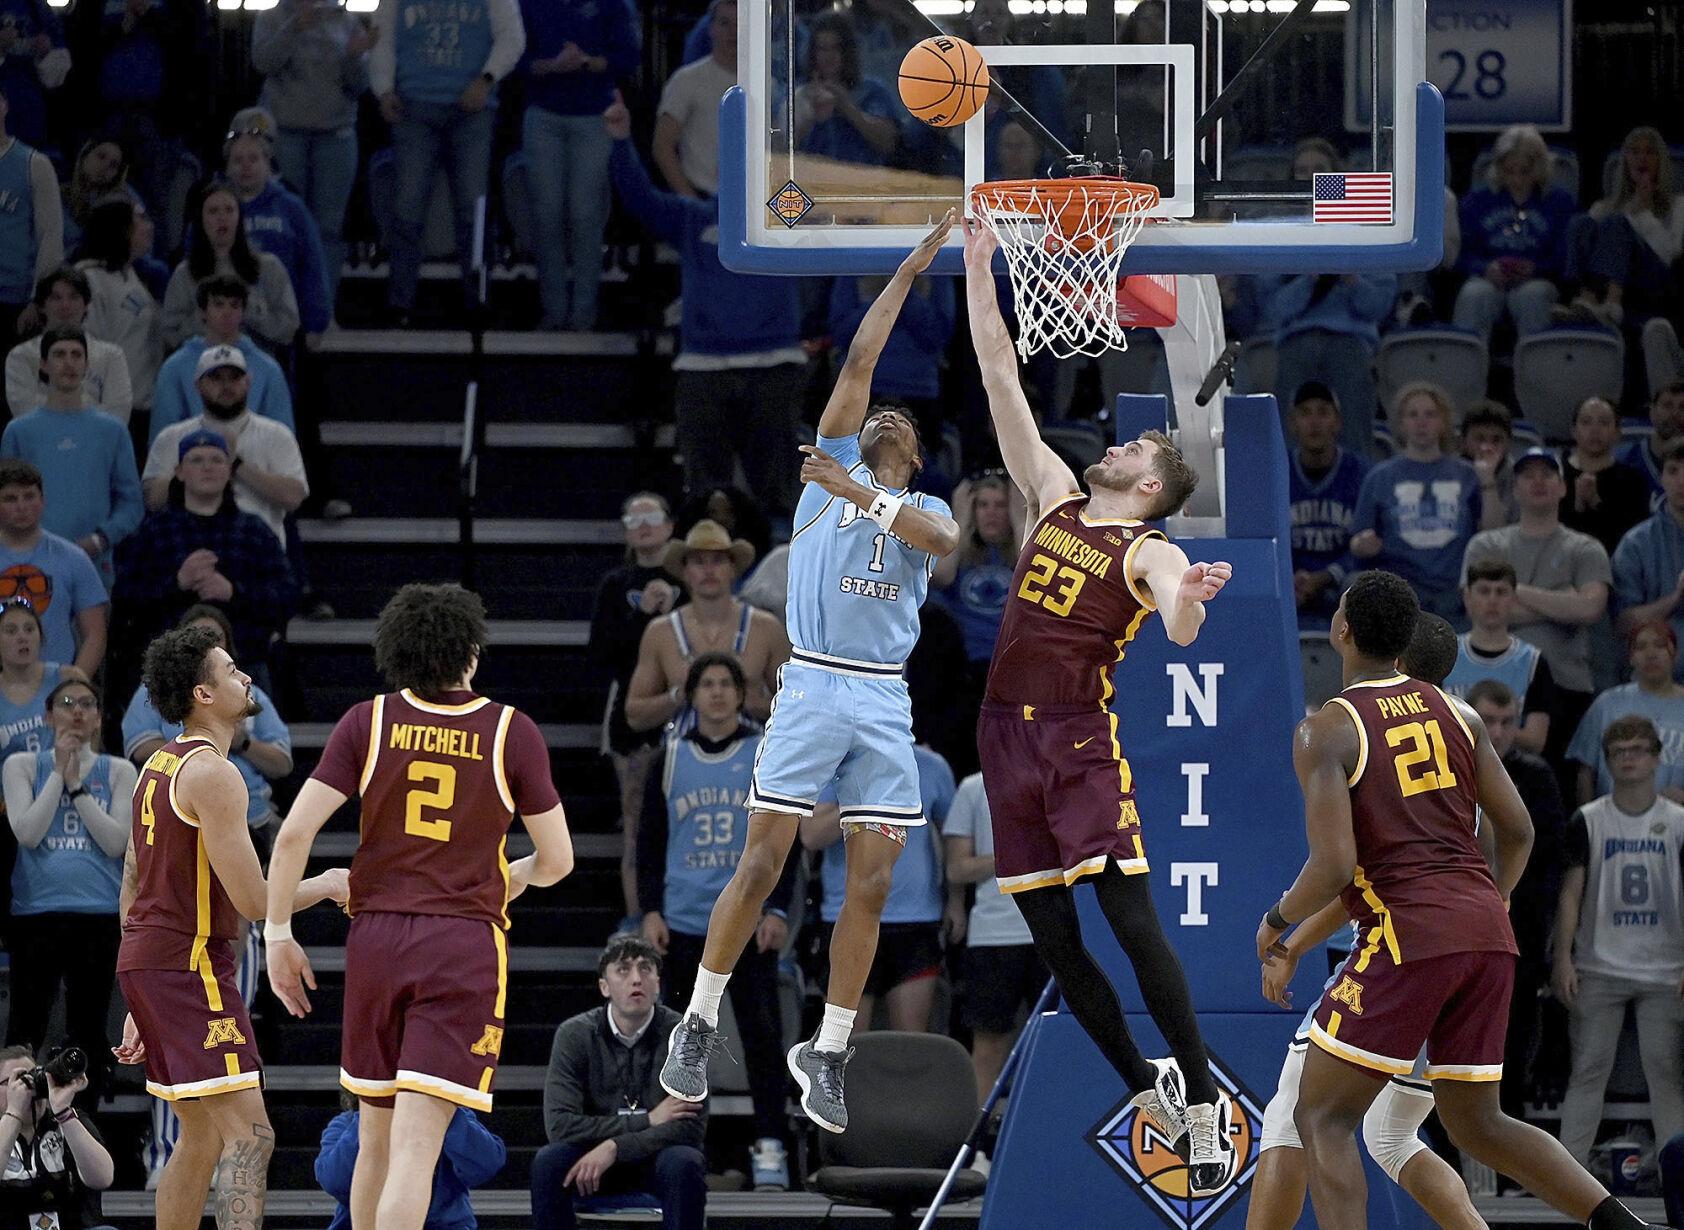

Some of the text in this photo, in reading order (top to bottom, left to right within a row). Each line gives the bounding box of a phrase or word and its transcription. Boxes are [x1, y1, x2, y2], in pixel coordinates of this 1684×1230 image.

[1431, 12, 1511, 31] CTION
[1440, 49, 1506, 99] 28
[779, 200, 802, 208] NIT
[868, 533, 886, 573] 1
[1034, 521, 1113, 580] MINNESOTA
[840, 576, 900, 602] STATE
[1018, 553, 1087, 617] 23
[1375, 691, 1430, 720] PAYNE
[0, 715, 46, 750] INDIA
[389, 723, 484, 761] MITCHELL
[1385, 719, 1457, 798] 21
[141, 778, 156, 846] 4
[404, 760, 457, 842] 2
[63, 811, 80, 835] 6
[694, 811, 734, 847] 33
[1605, 838, 1666, 860] INDIANA
[1329, 974, 1364, 1016] M
[203, 1017, 247, 1050] M
